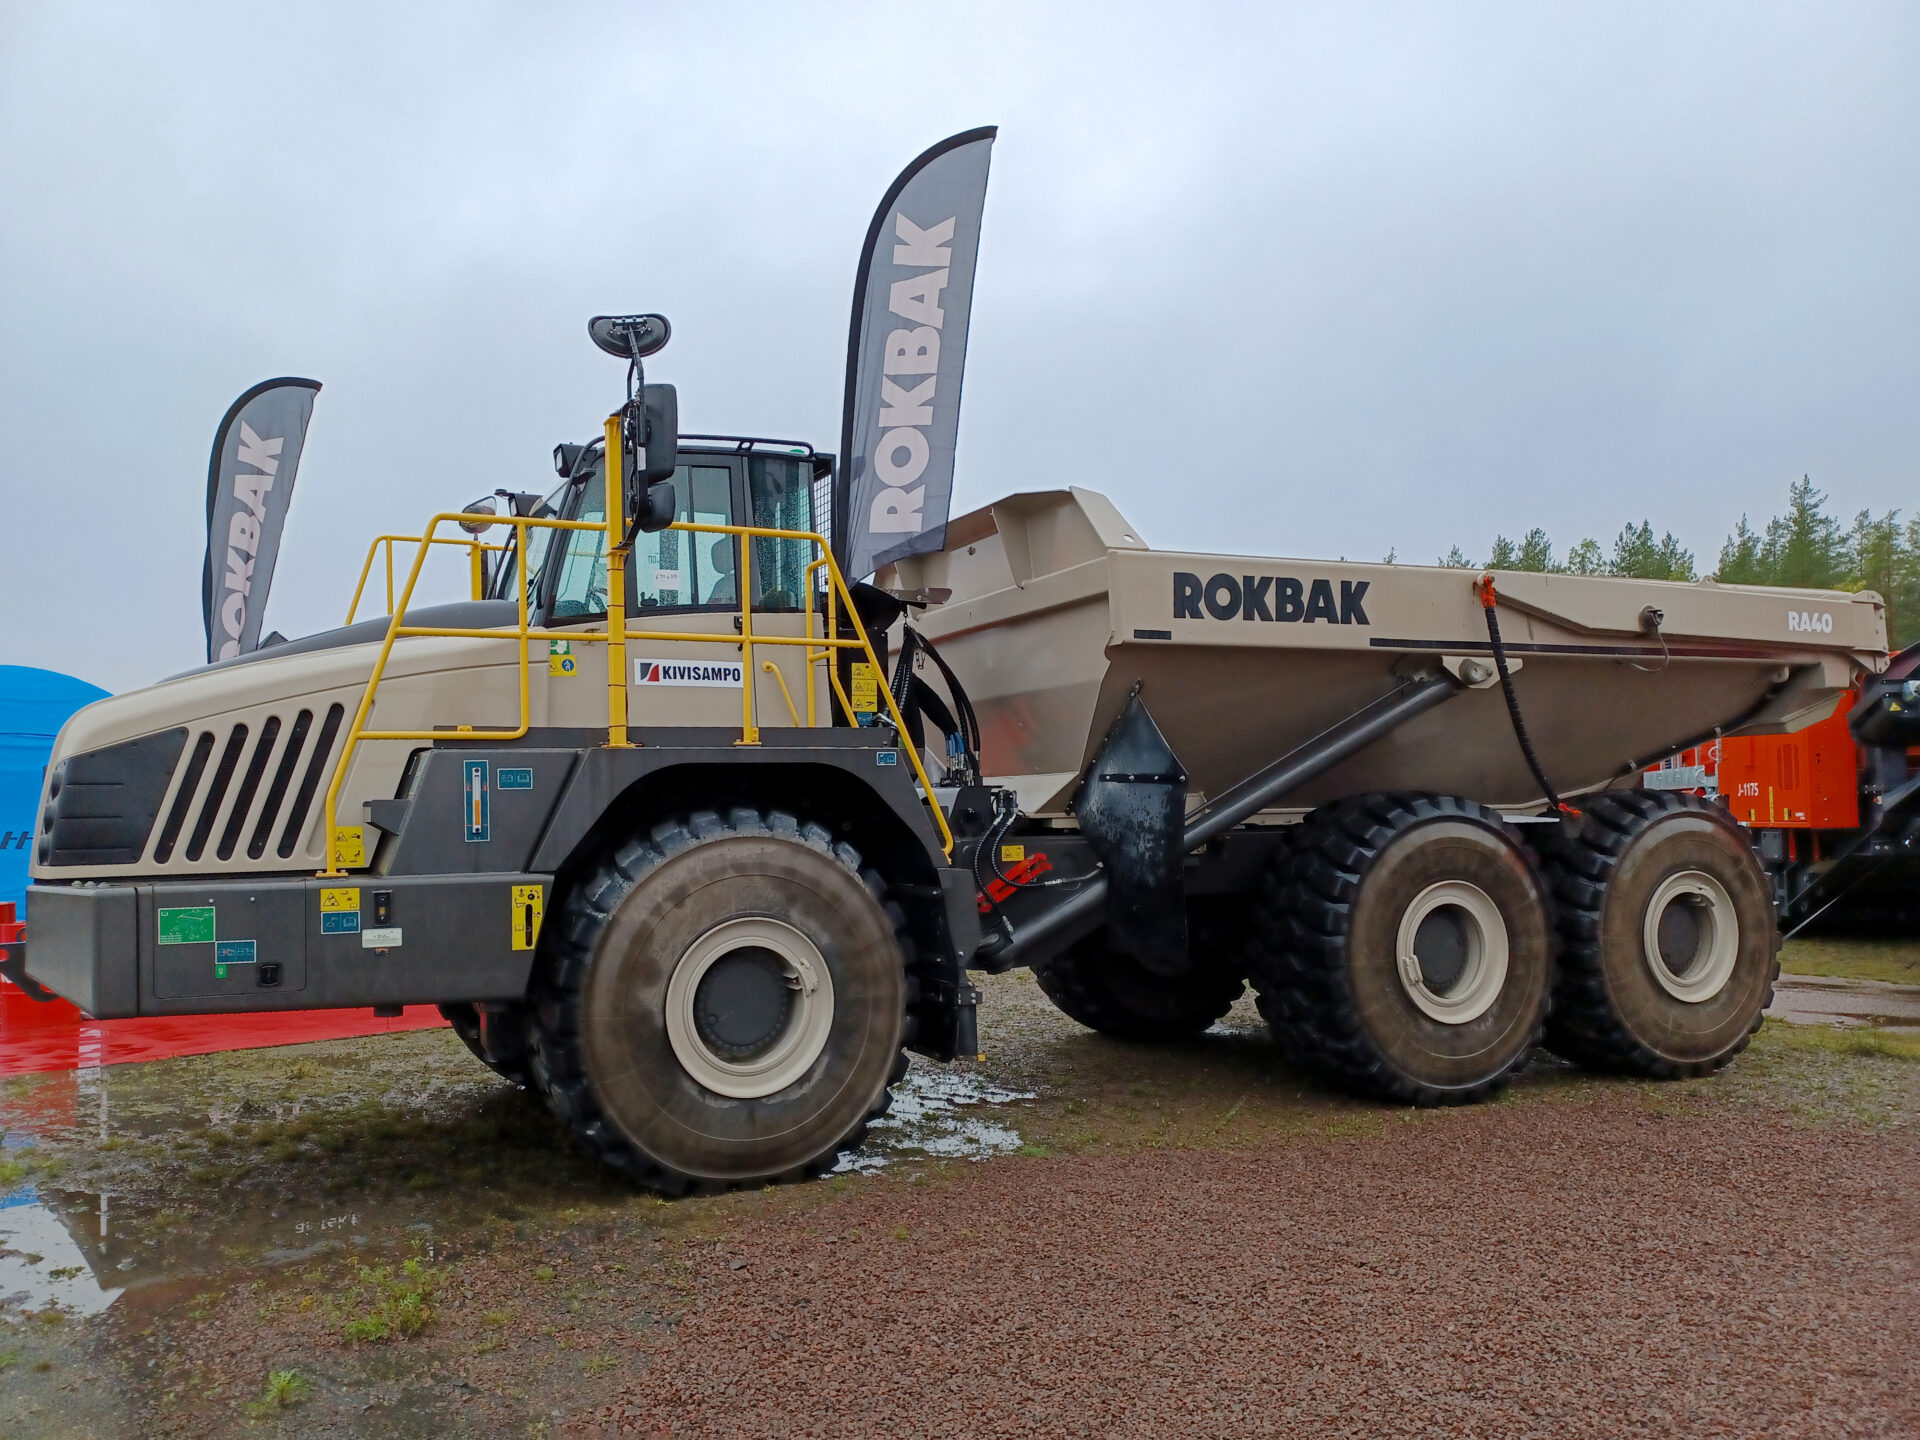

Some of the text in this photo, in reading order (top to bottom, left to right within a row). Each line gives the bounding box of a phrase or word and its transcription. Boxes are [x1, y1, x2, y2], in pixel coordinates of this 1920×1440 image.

[869, 211, 956, 534] ROKBAK
[1173, 572, 1371, 625] ROKBAK
[1788, 611, 1832, 633] RA40
[662, 665, 741, 682] KIVISAMPO
[1738, 782, 1759, 797] J-1175
